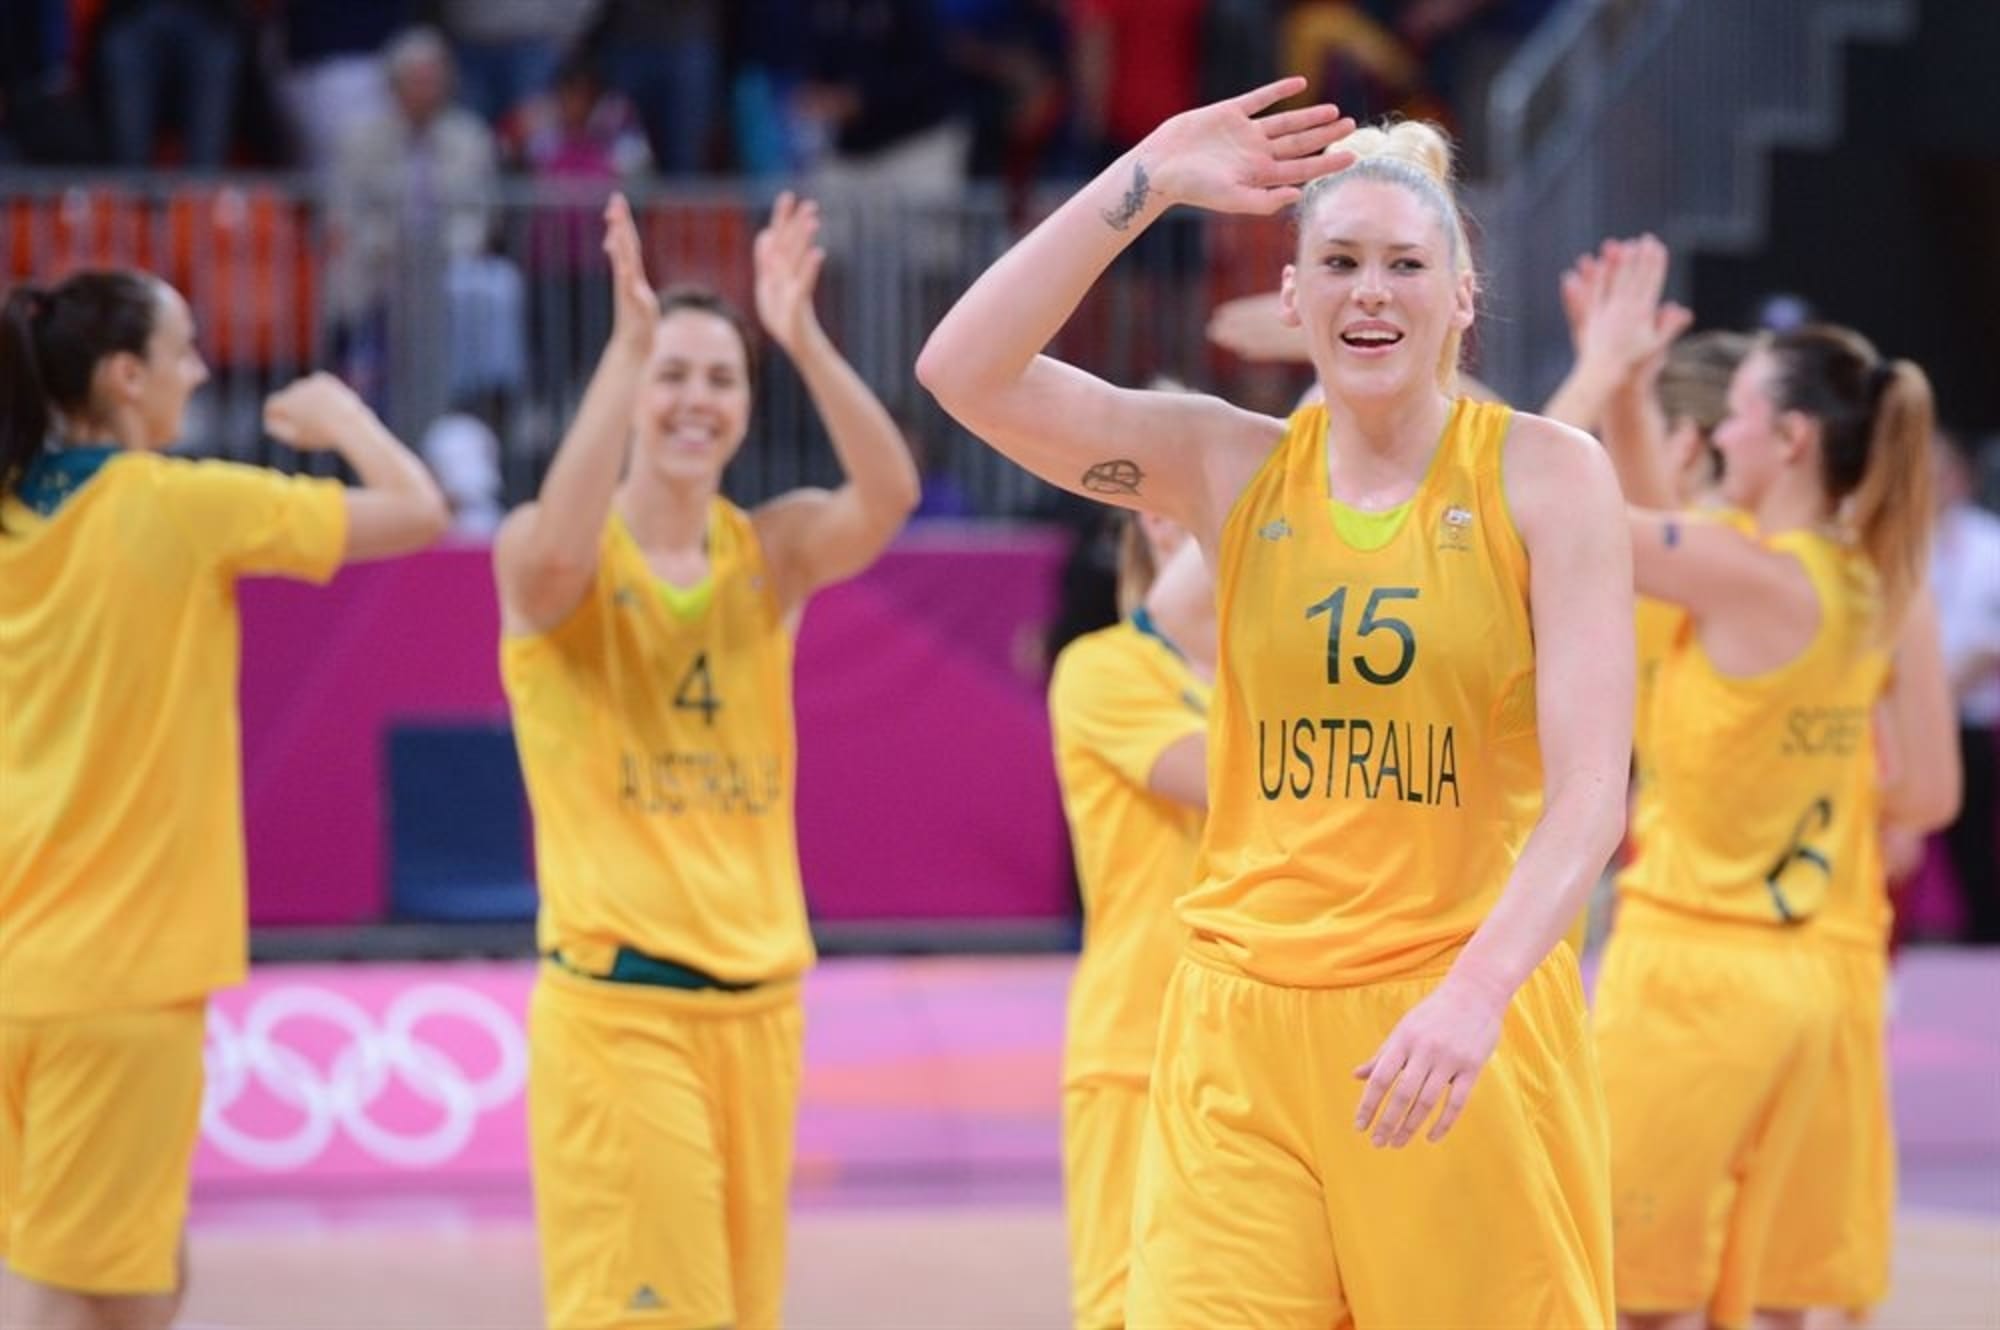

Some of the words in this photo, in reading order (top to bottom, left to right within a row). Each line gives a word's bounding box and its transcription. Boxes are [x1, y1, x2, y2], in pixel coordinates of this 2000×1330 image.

[1304, 585, 1420, 686] 15
[672, 648, 722, 729] 4
[1257, 716, 1461, 808] USTRALIA
[1765, 793, 1832, 927] 6
